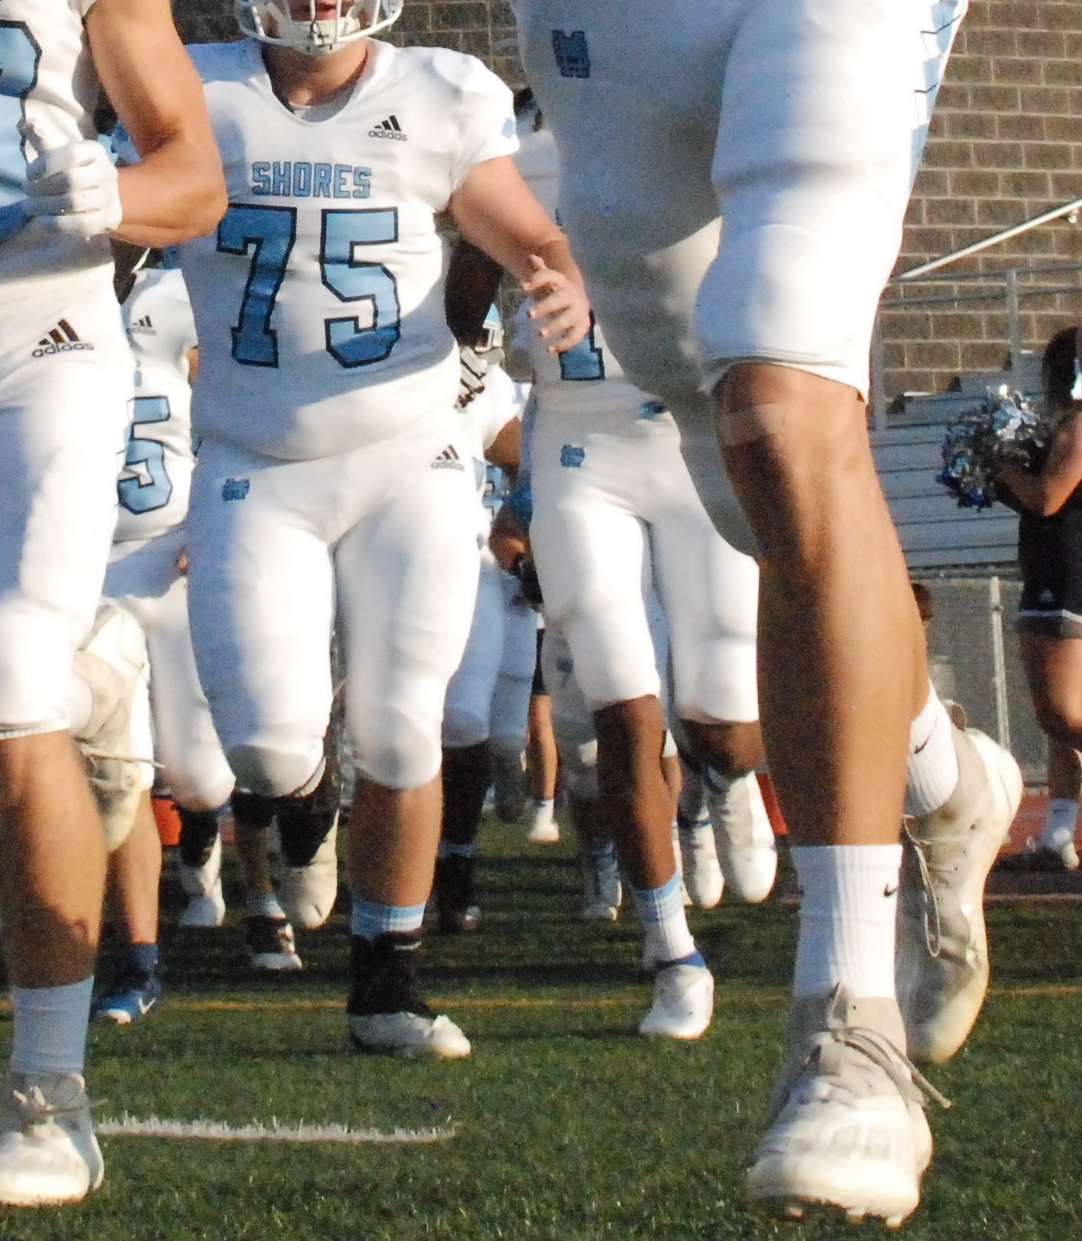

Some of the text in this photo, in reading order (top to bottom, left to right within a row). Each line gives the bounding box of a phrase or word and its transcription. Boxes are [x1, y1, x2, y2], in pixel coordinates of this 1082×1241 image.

[368, 128, 408, 142] adidas
[251, 161, 373, 200] SHORES
[216, 203, 402, 370] 75
[31, 342, 95, 358] adidas
